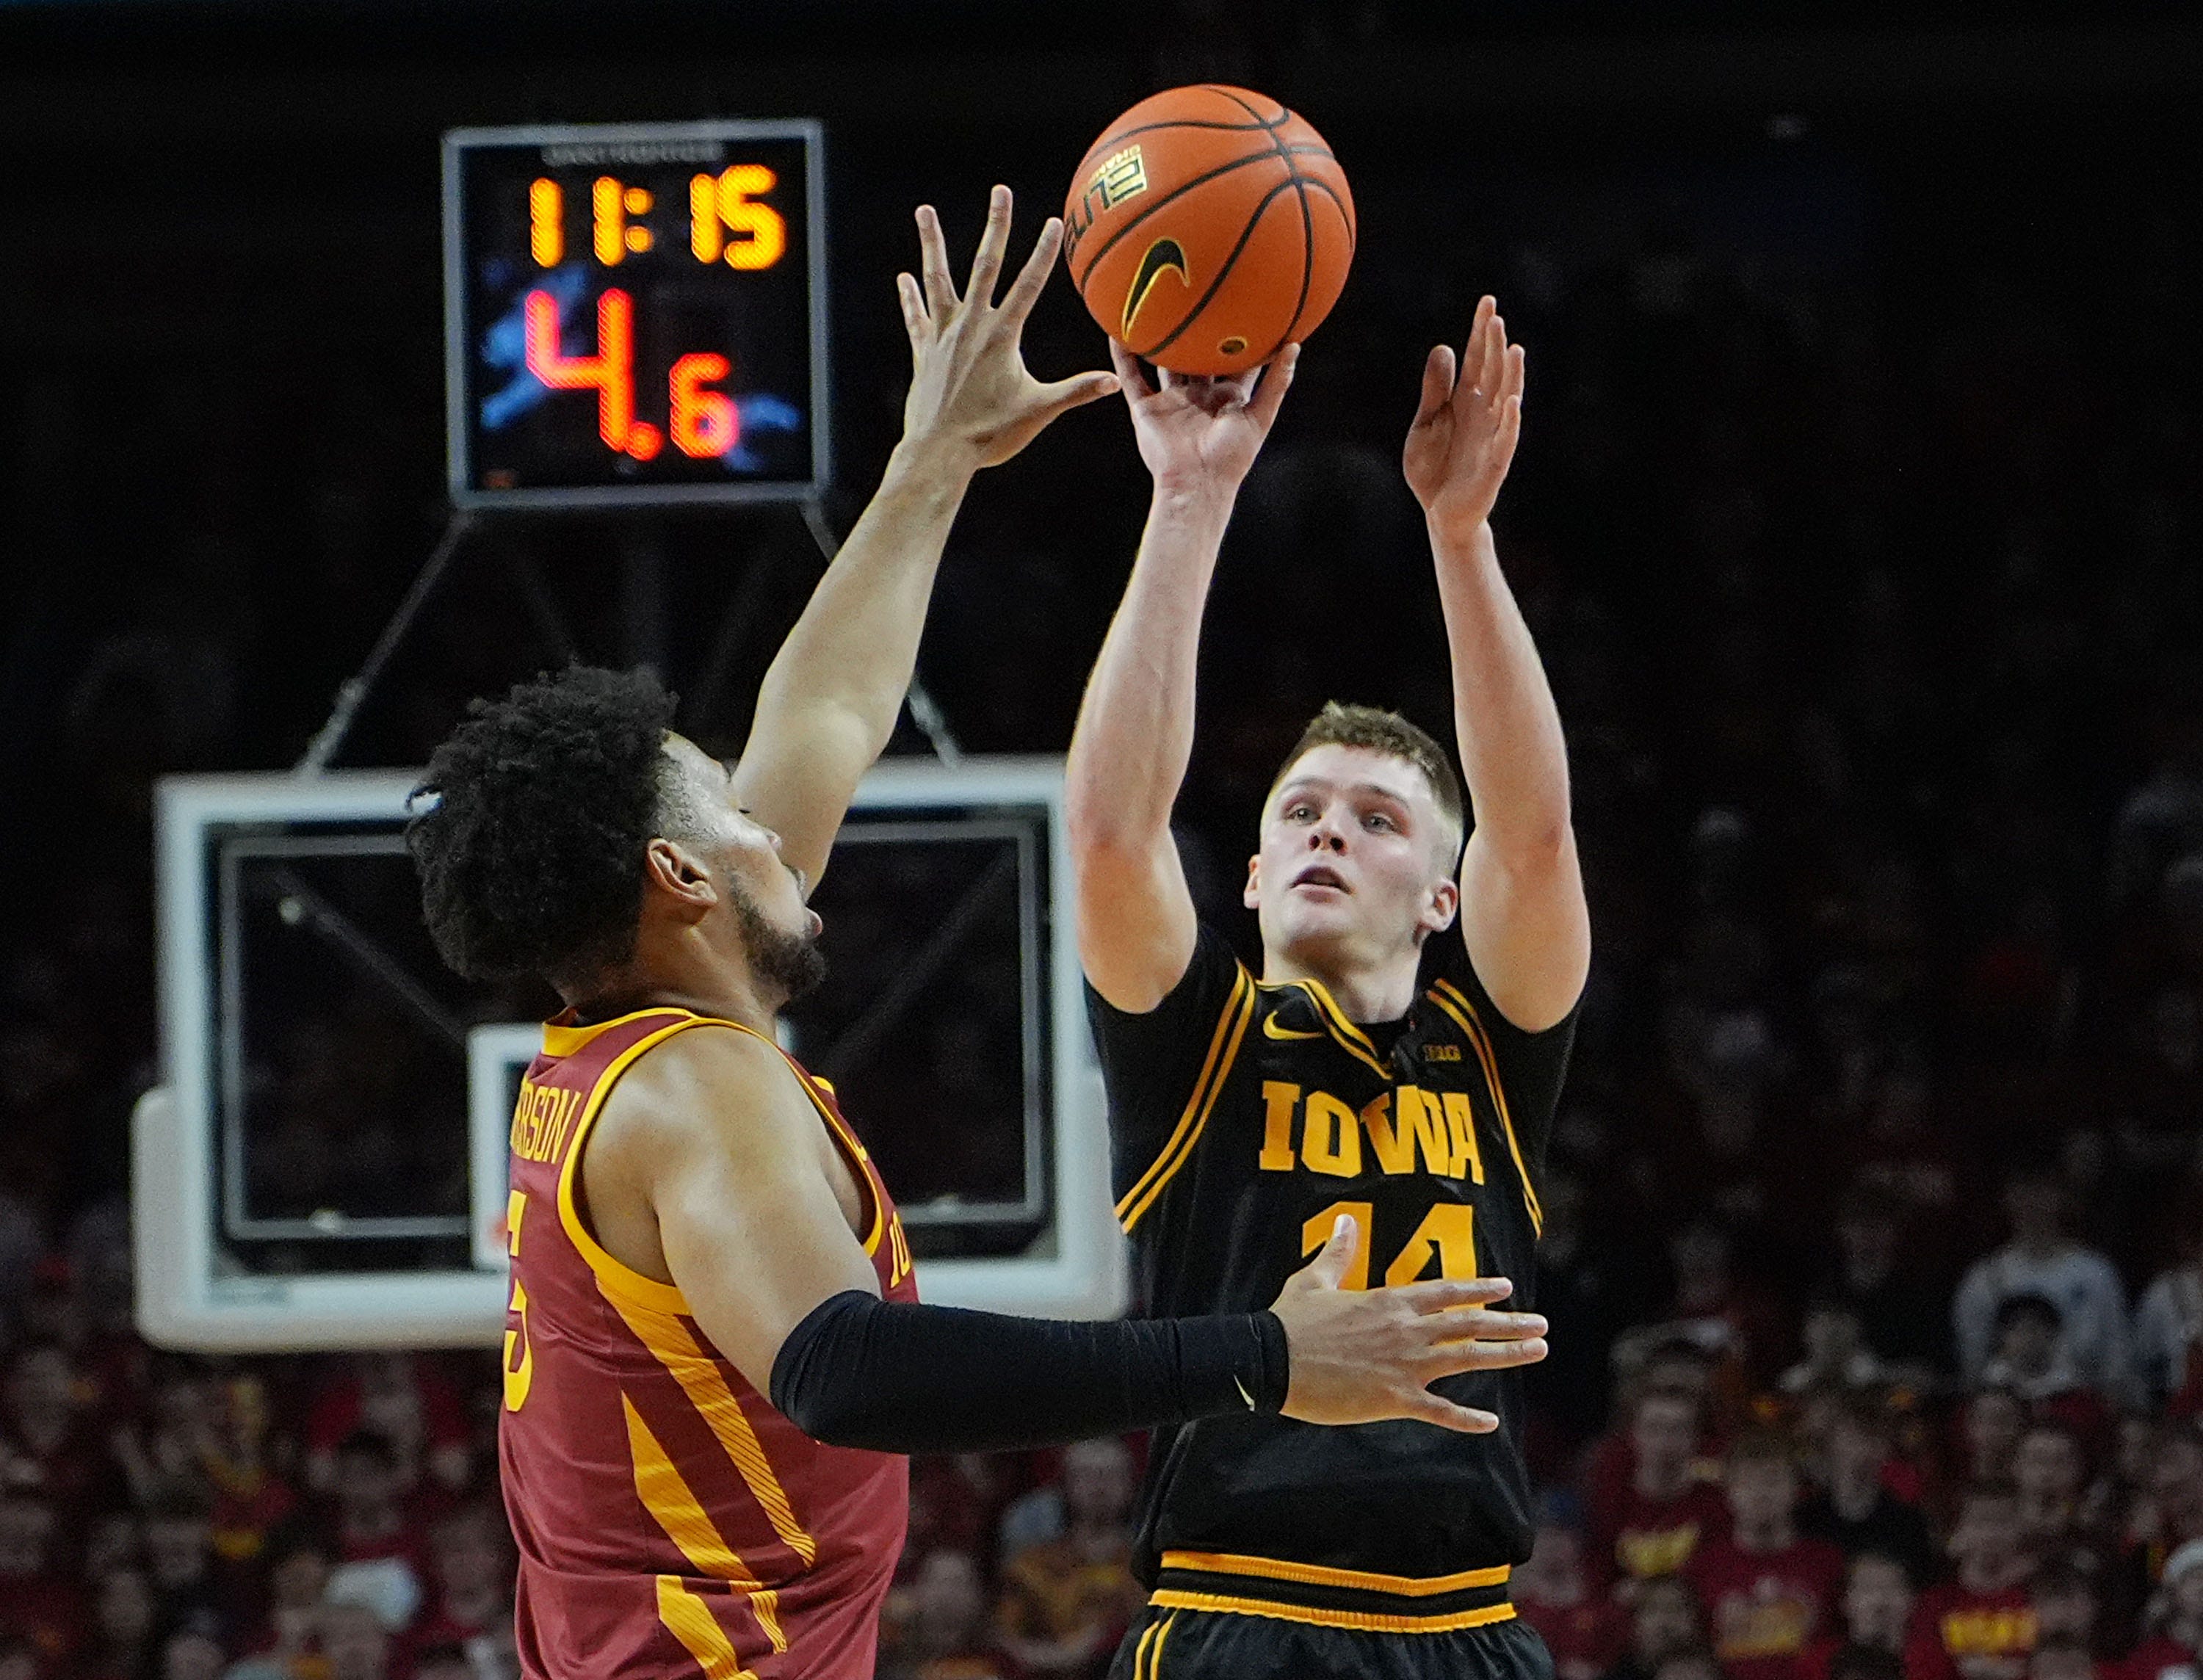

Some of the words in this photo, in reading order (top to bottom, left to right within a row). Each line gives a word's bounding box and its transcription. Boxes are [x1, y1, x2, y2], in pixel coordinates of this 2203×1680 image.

[530, 164, 786, 269] 11:15
[525, 288, 739, 460] 4.6
[1259, 1081, 1484, 1185] IOWA
[1301, 1201, 1486, 1312] 14
